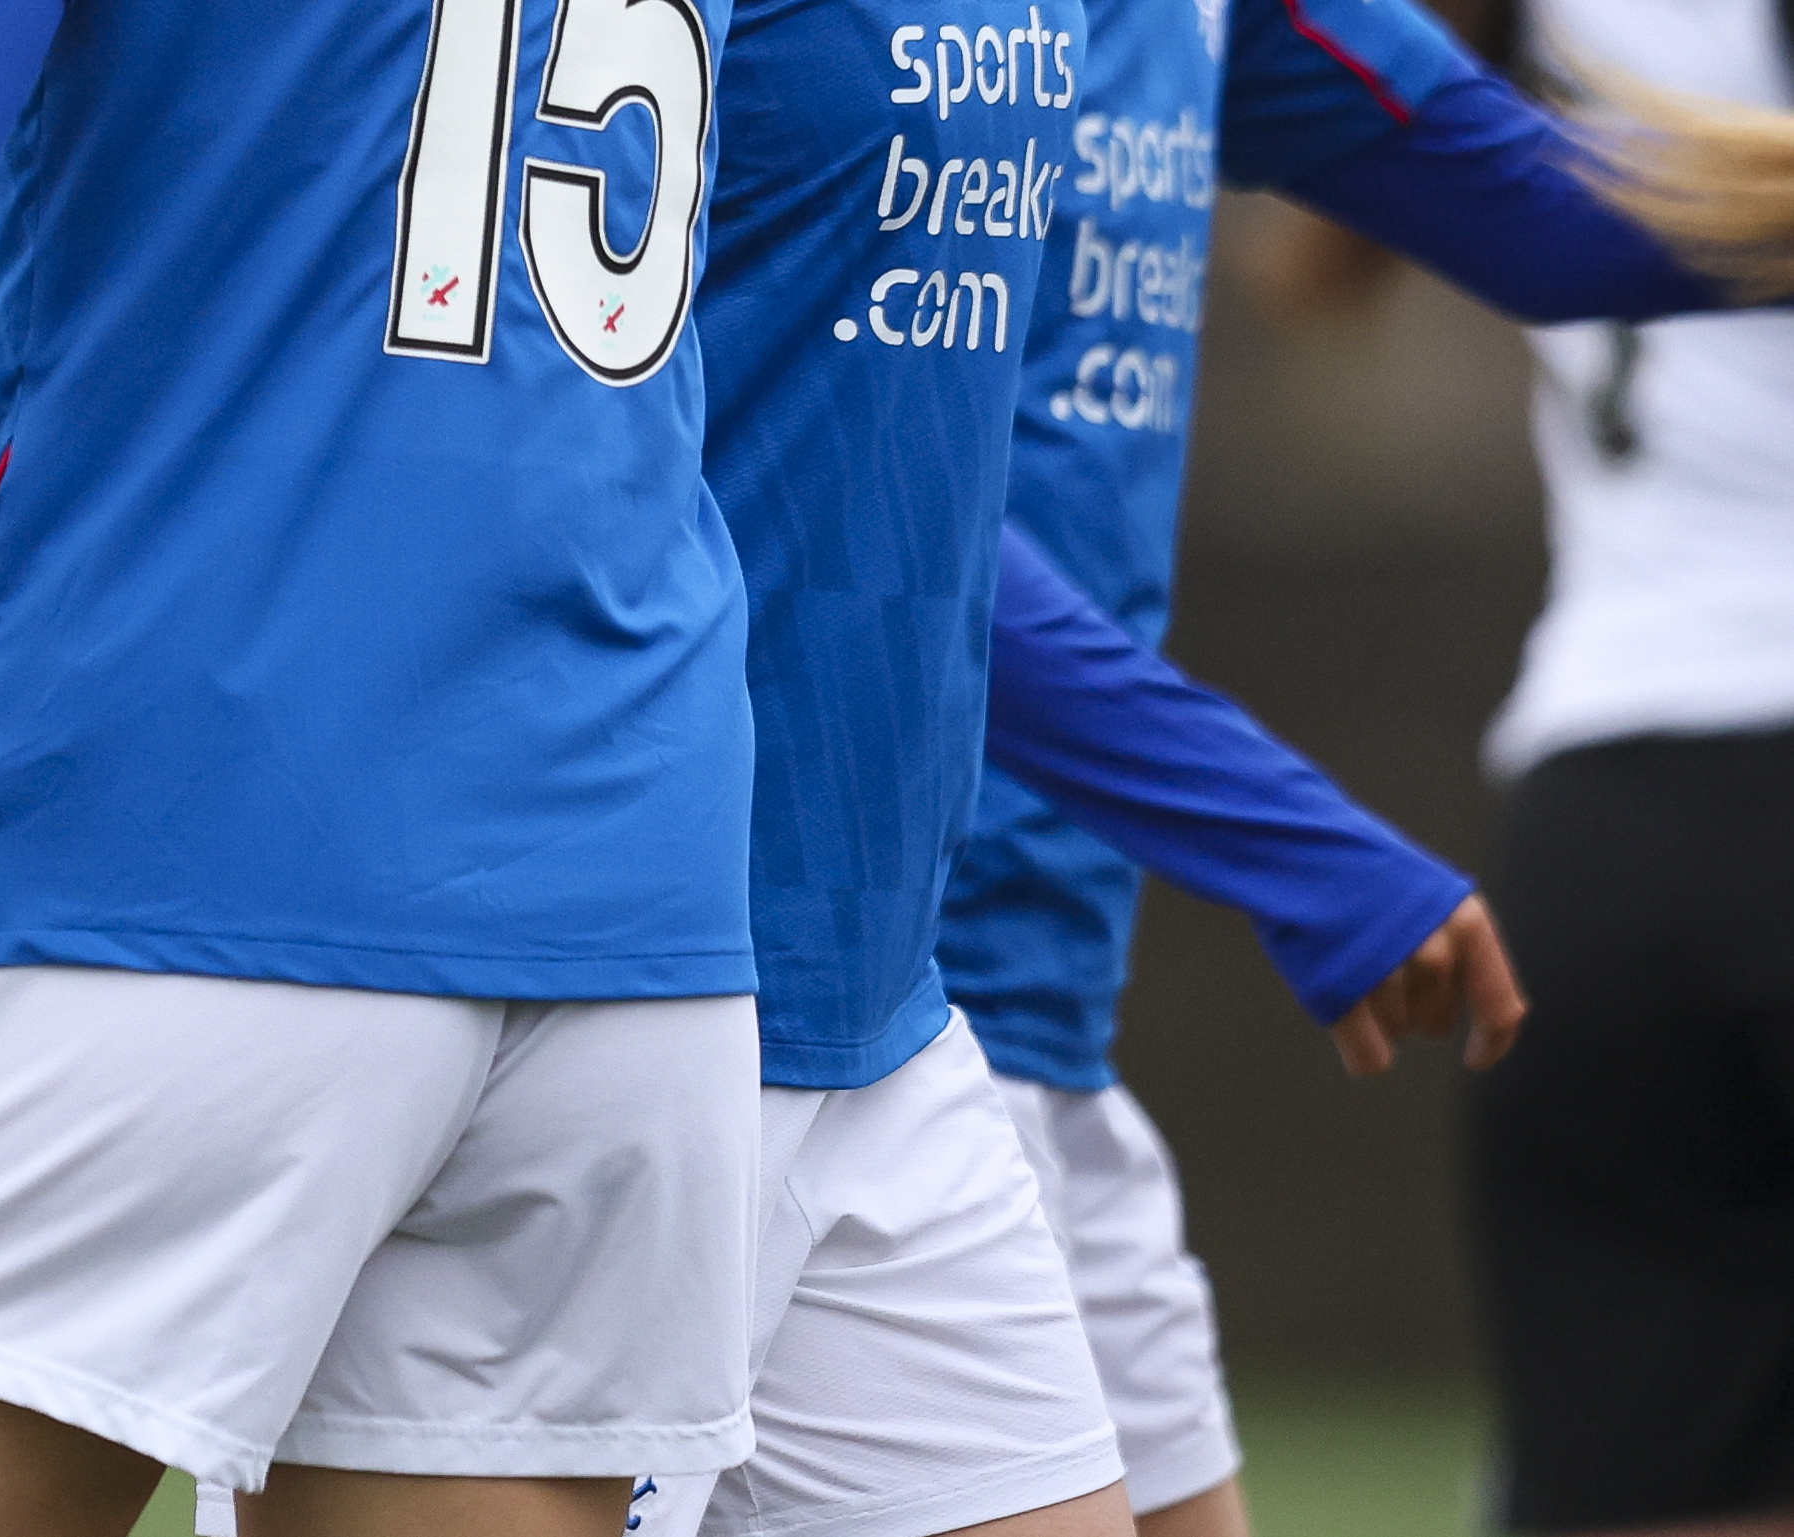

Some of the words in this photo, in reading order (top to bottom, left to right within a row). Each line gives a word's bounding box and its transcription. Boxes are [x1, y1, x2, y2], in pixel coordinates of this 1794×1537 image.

[891, 5, 1073, 121] sports
[878, 134, 1064, 241] break
[1074, 109, 1215, 211] sports
[833, 269, 1008, 353] .com
